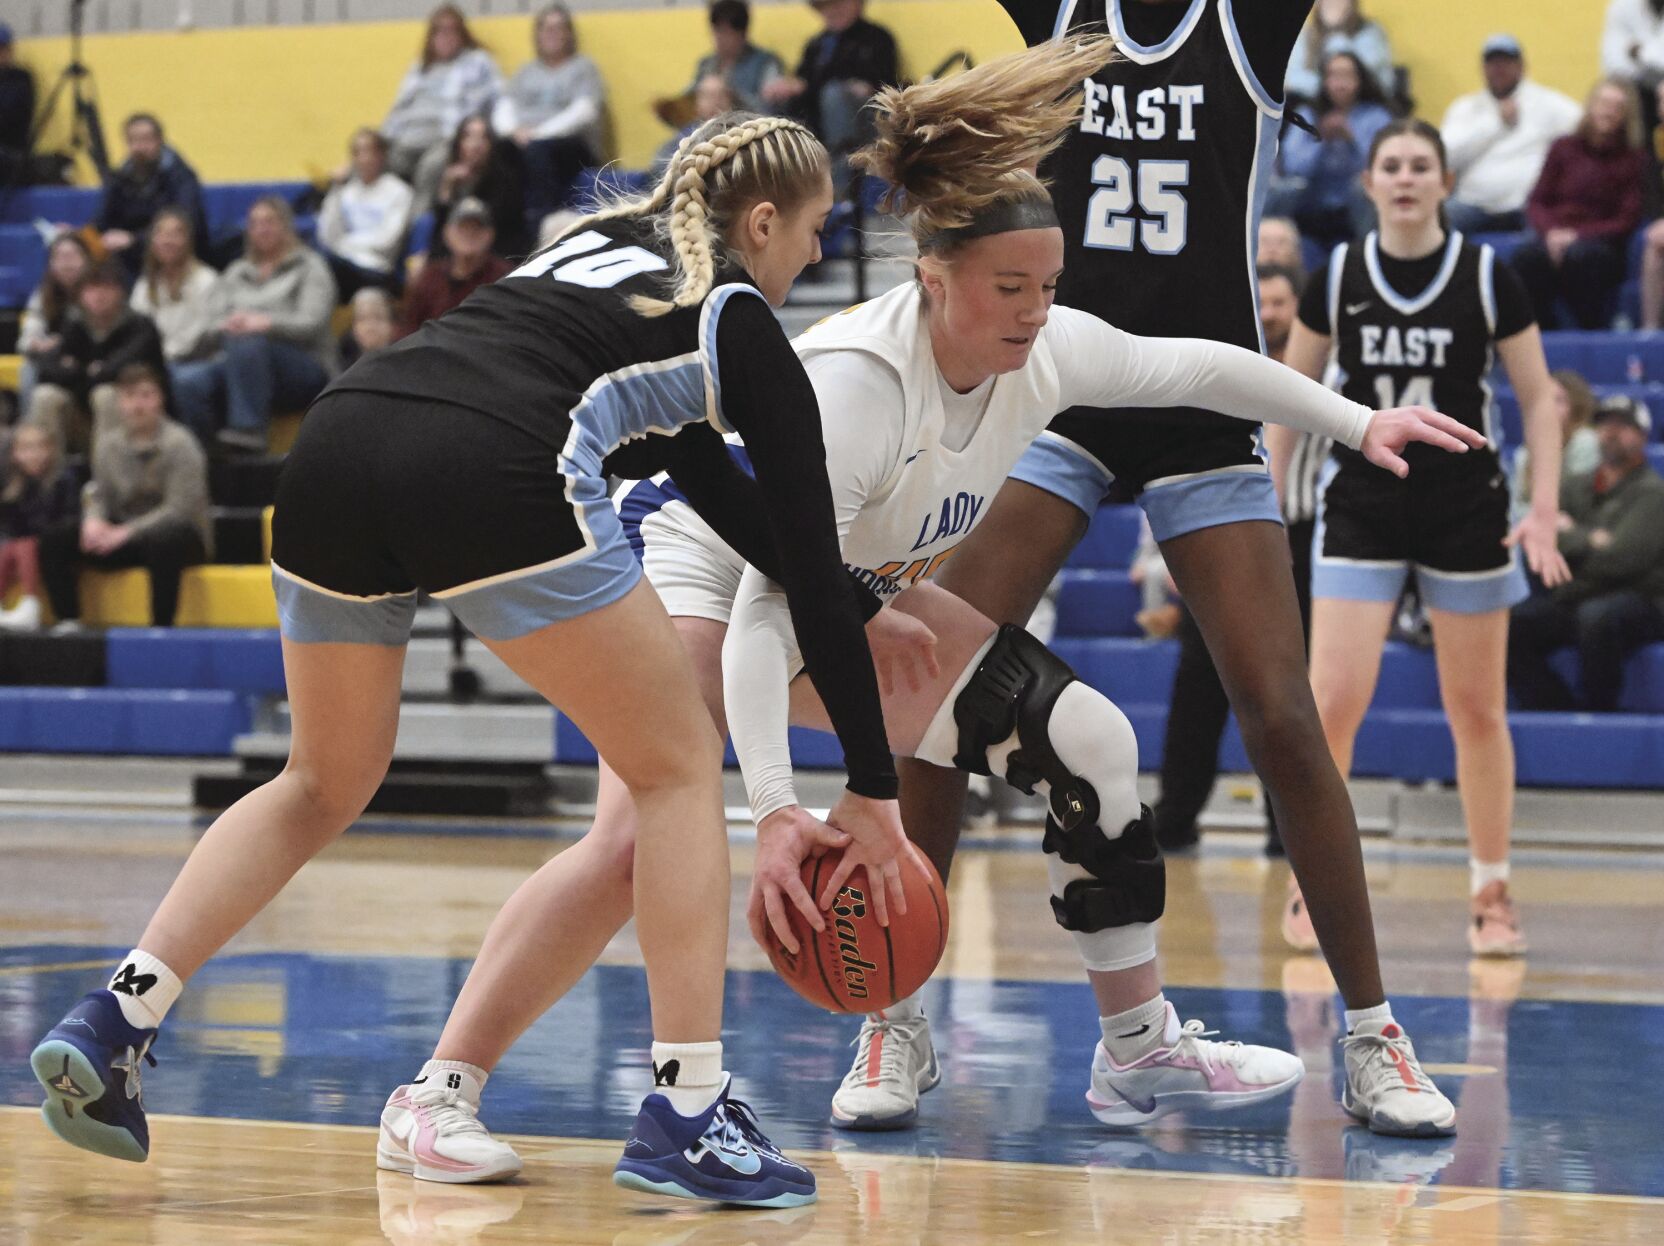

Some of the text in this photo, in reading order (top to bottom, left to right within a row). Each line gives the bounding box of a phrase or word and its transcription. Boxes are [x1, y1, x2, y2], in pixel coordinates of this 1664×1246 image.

[1080, 77, 1204, 141] EAST
[1082, 153, 1190, 256] 25
[505, 229, 669, 289] 10
[1360, 324, 1454, 367] EAST
[909, 491, 985, 553] LADY
[831, 886, 877, 1000] Baden
